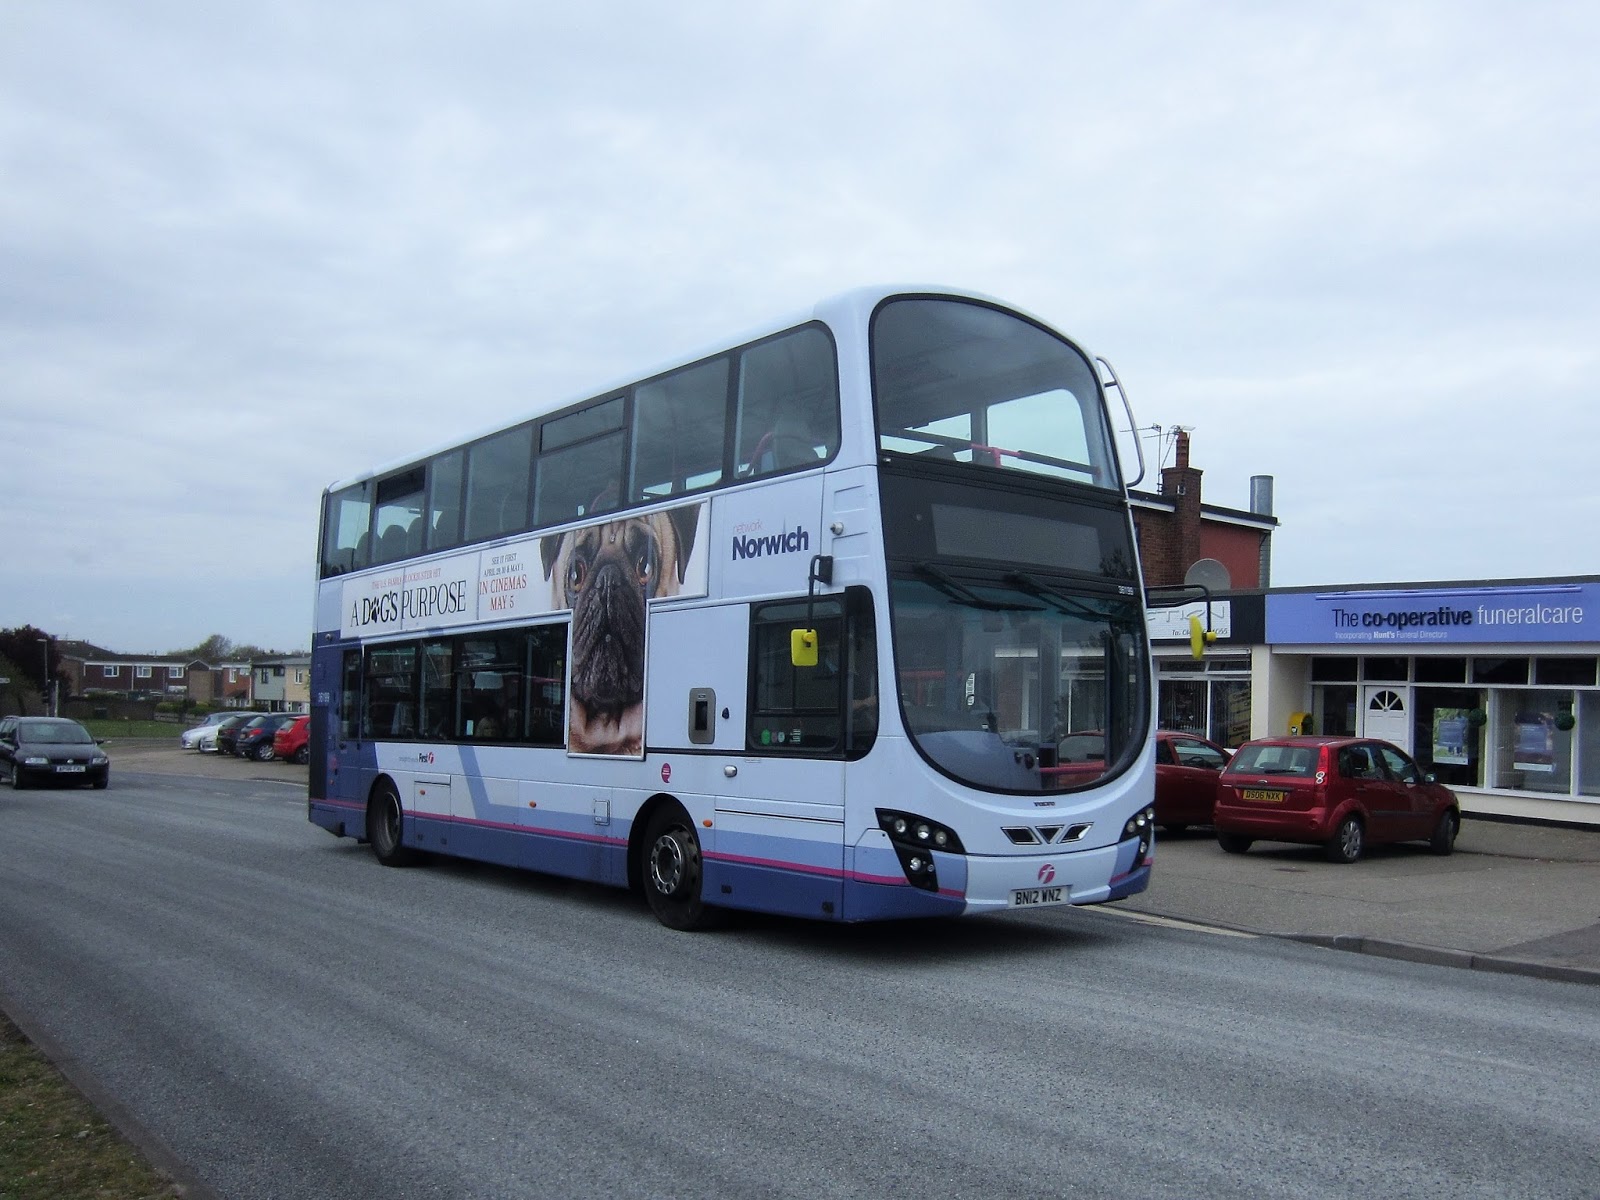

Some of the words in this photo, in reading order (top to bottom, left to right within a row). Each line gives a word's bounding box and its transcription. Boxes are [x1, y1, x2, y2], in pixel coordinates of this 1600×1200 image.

[732, 525, 809, 561] Norwich
[505, 552, 517, 562] FIRST
[510, 563, 520, 572] MAY
[479, 580, 488, 595] IN
[491, 573, 527, 594] CINEMAS
[350, 600, 360, 628] A
[401, 580, 467, 620] PURPOSE
[490, 594, 508, 611] MAY
[509, 594, 515, 609] 5
[1331, 608, 1359, 627] The
[1361, 606, 1472, 631] co-operative
[1477, 603, 1583, 625] funeralcare
[1335, 631, 1372, 640] Incorporating
[1373, 630, 1396, 639] Hunt's
[1396, 630, 1418, 639] Funeral
[1420, 630, 1448, 639] Directors
[1246, 791, 1264, 799] DS06
[1266, 791, 1280, 800] NXK
[1015, 890, 1039, 905] BN12
[1041, 888, 1062, 903] WNZ
